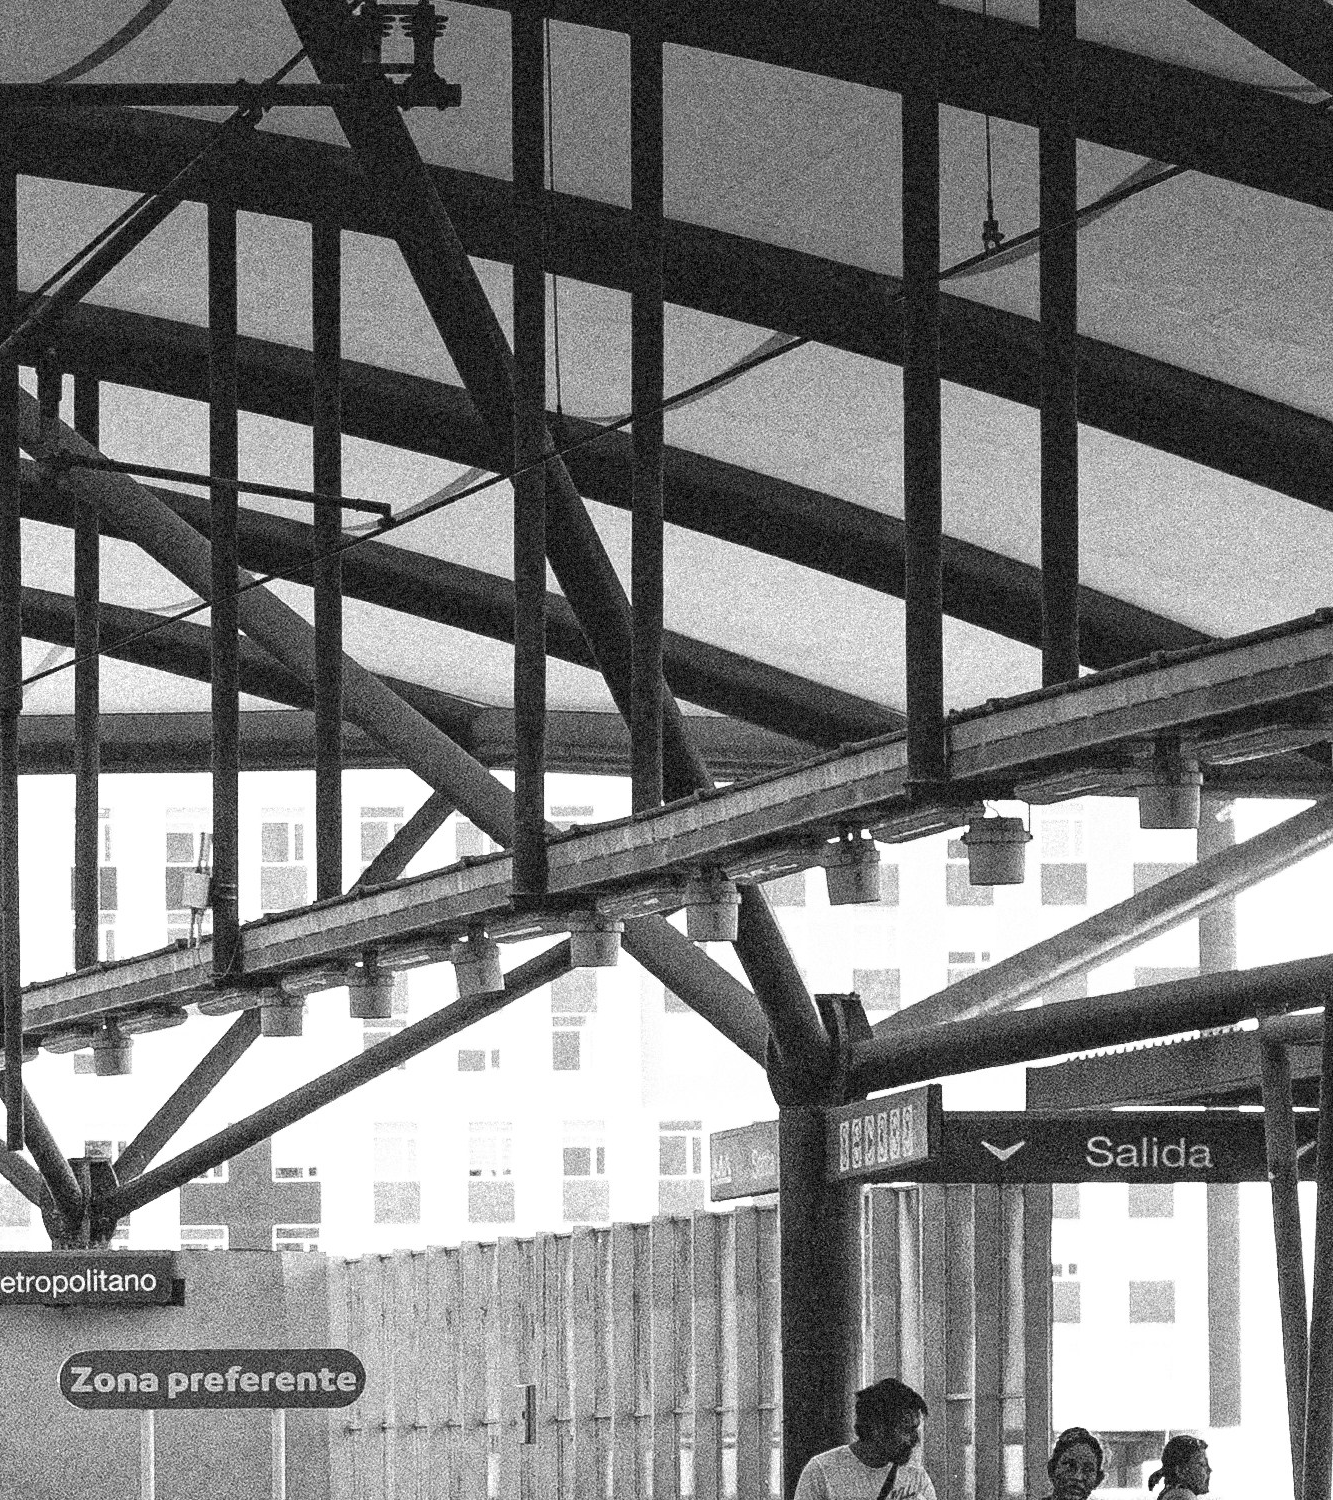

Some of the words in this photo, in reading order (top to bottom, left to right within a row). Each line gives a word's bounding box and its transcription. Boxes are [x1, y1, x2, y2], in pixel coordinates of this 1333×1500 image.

[1086, 1136, 1214, 1168] Salida
[70, 1366, 158, 1394] Zona
[167, 1365, 357, 1399] preferente
